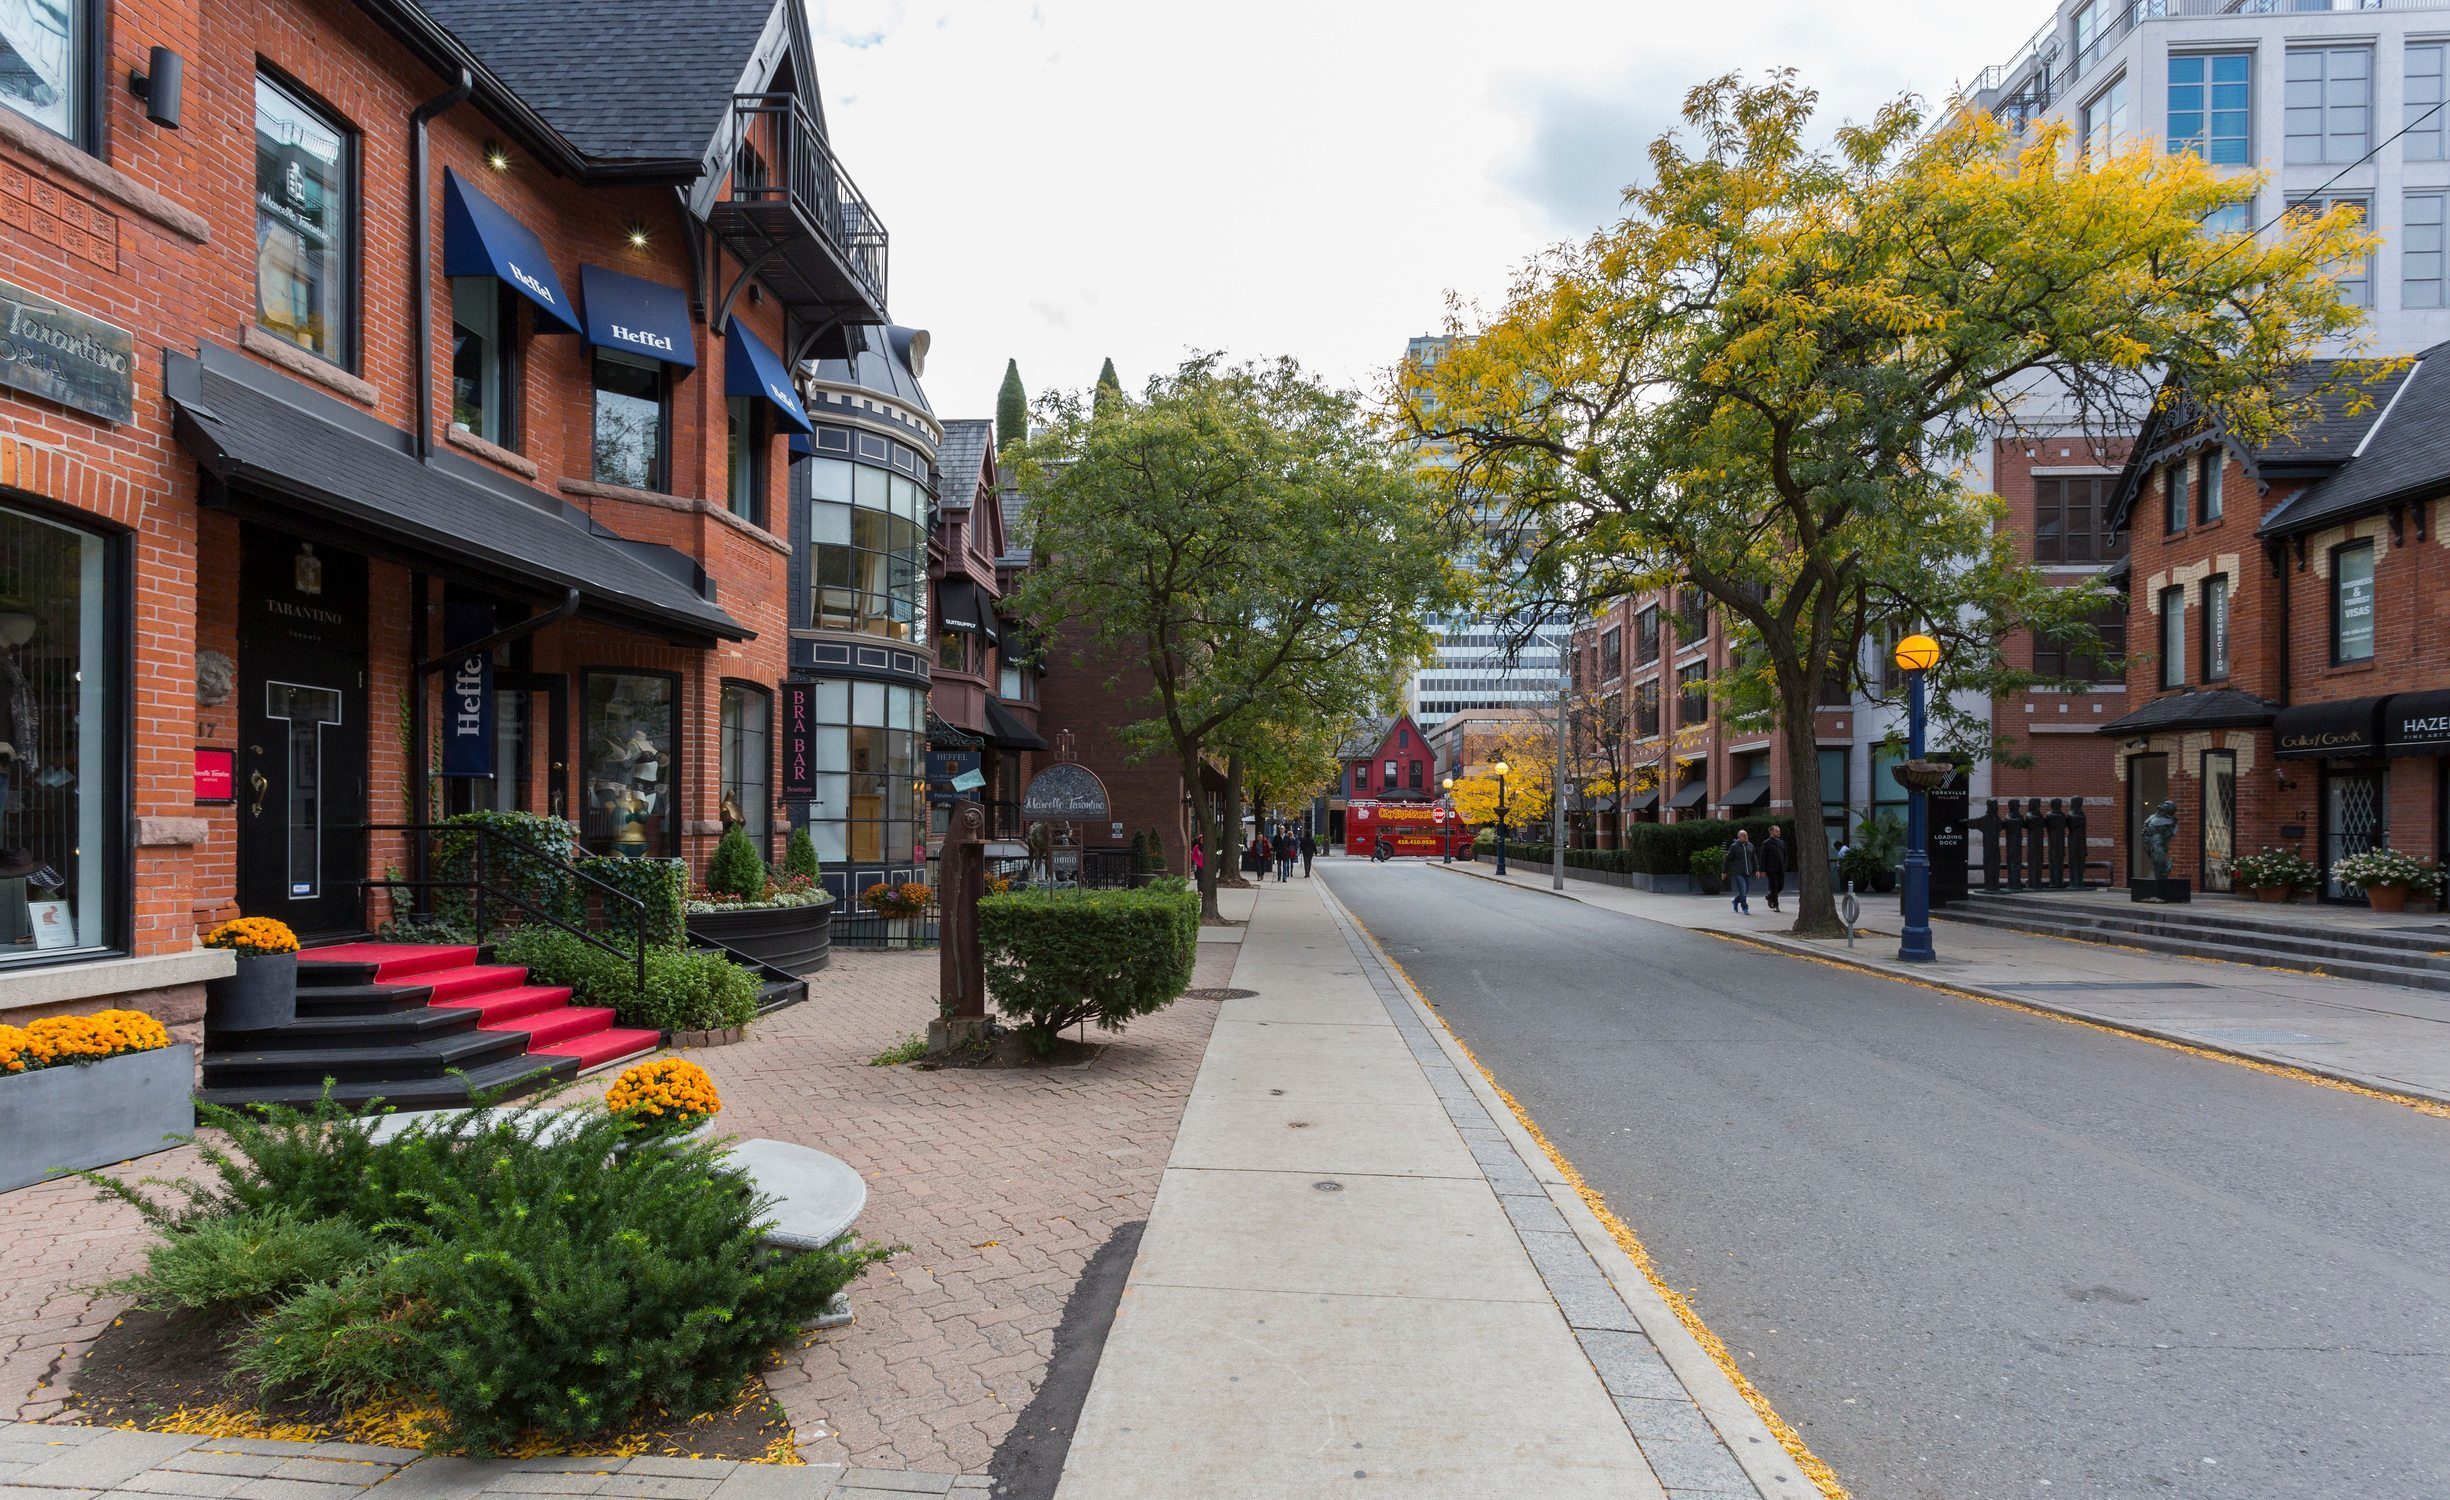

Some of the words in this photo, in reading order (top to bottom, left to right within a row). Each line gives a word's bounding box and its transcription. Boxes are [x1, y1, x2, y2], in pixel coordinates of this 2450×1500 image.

[261, 192, 297, 222] Marcello
[297, 213, 330, 242] Tarantino
[508, 261, 555, 304] Heffel
[0, 296, 128, 375] Tarantino
[611, 324, 673, 351] Heffel
[2341, 576, 2374, 590] BUSINESS
[2352, 586, 2362, 597] &
[266, 599, 342, 625] TARANTINO
[2344, 605, 2370, 618] VISAS
[945, 618, 977, 629] SUITSUPPLY
[456, 653, 482, 737] Heffe
[793, 690, 806, 732] BRA
[197, 722, 216, 738] 17
[2404, 716, 2450, 732] HAZE
[2281, 733, 2322, 748] Gallery
[793, 738, 806, 780] BAR
[936, 753, 968, 761] HEFFEL
[1025, 797, 1064, 810] Marcello
[2295, 810, 2308, 821] 12
